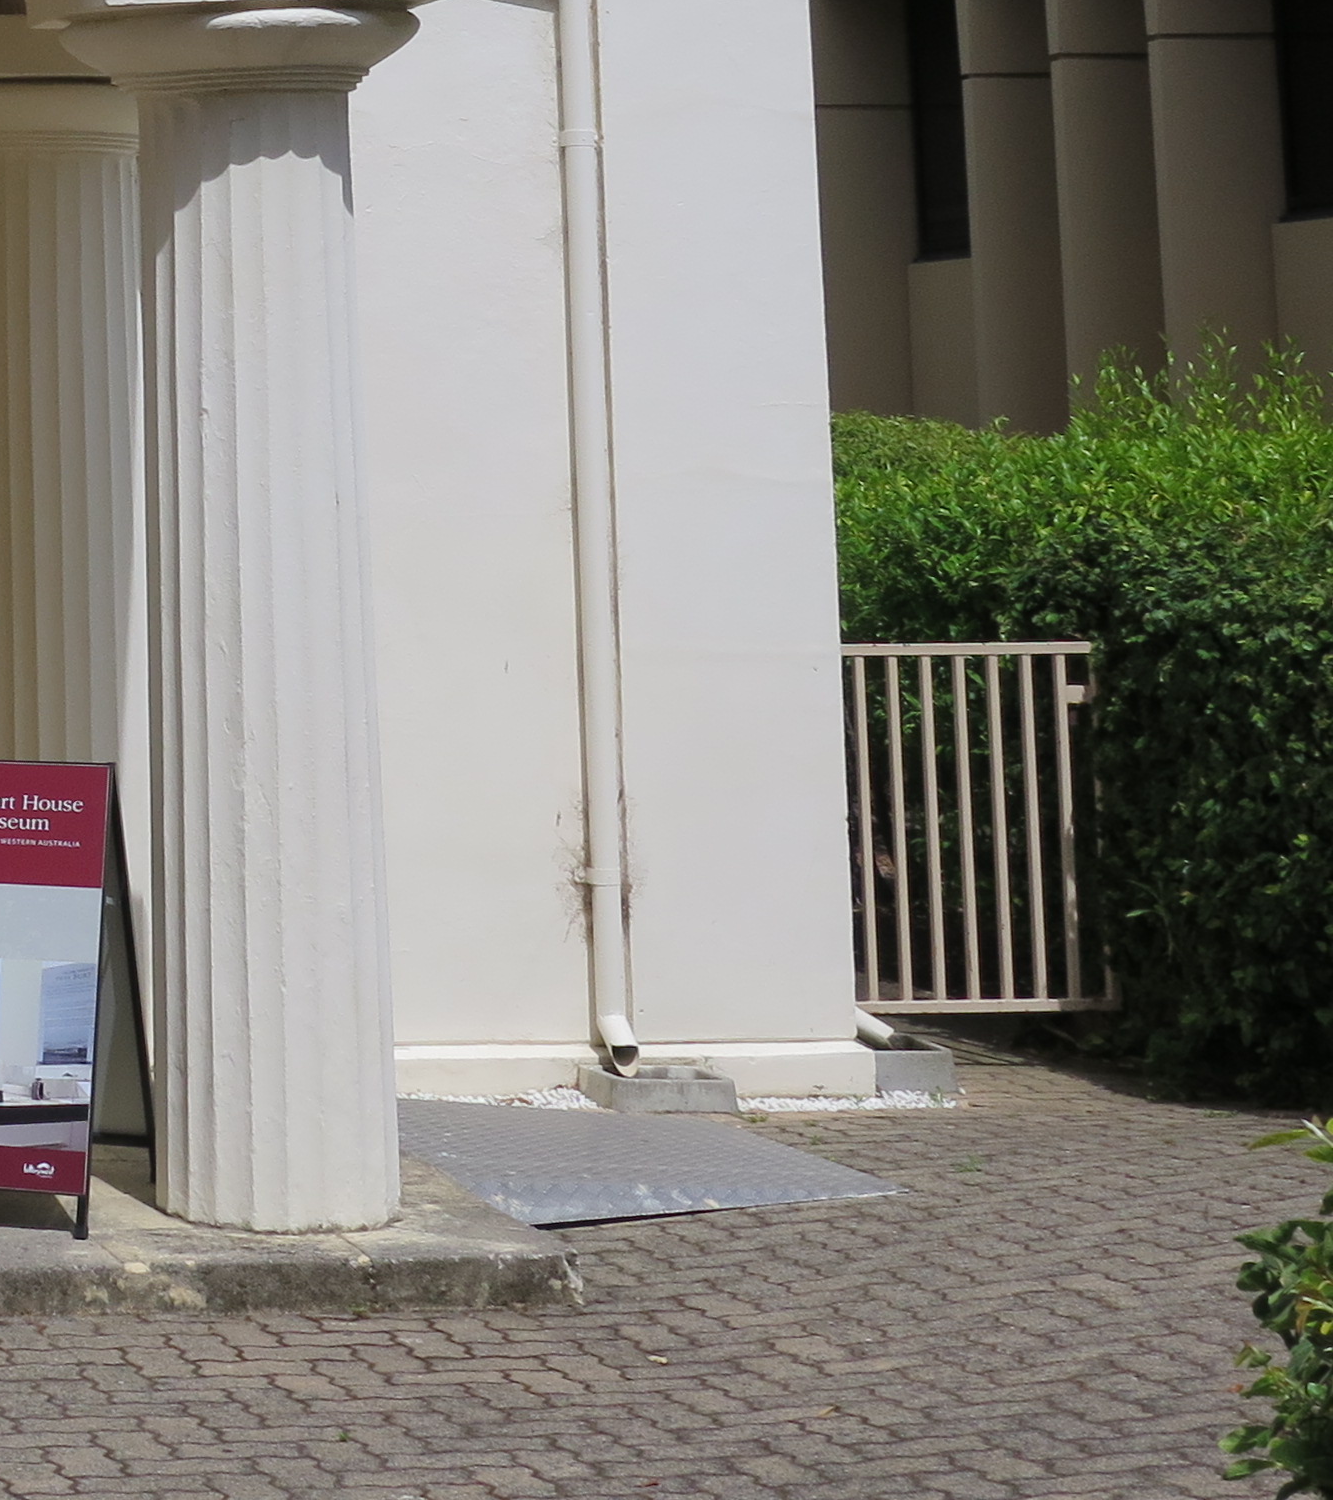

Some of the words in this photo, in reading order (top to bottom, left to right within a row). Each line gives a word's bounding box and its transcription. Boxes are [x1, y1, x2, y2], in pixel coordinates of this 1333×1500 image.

[22, 794, 84, 812] House
[1, 838, 36, 846] WESTERN
[38, 839, 81, 847] AUSTRALIA
